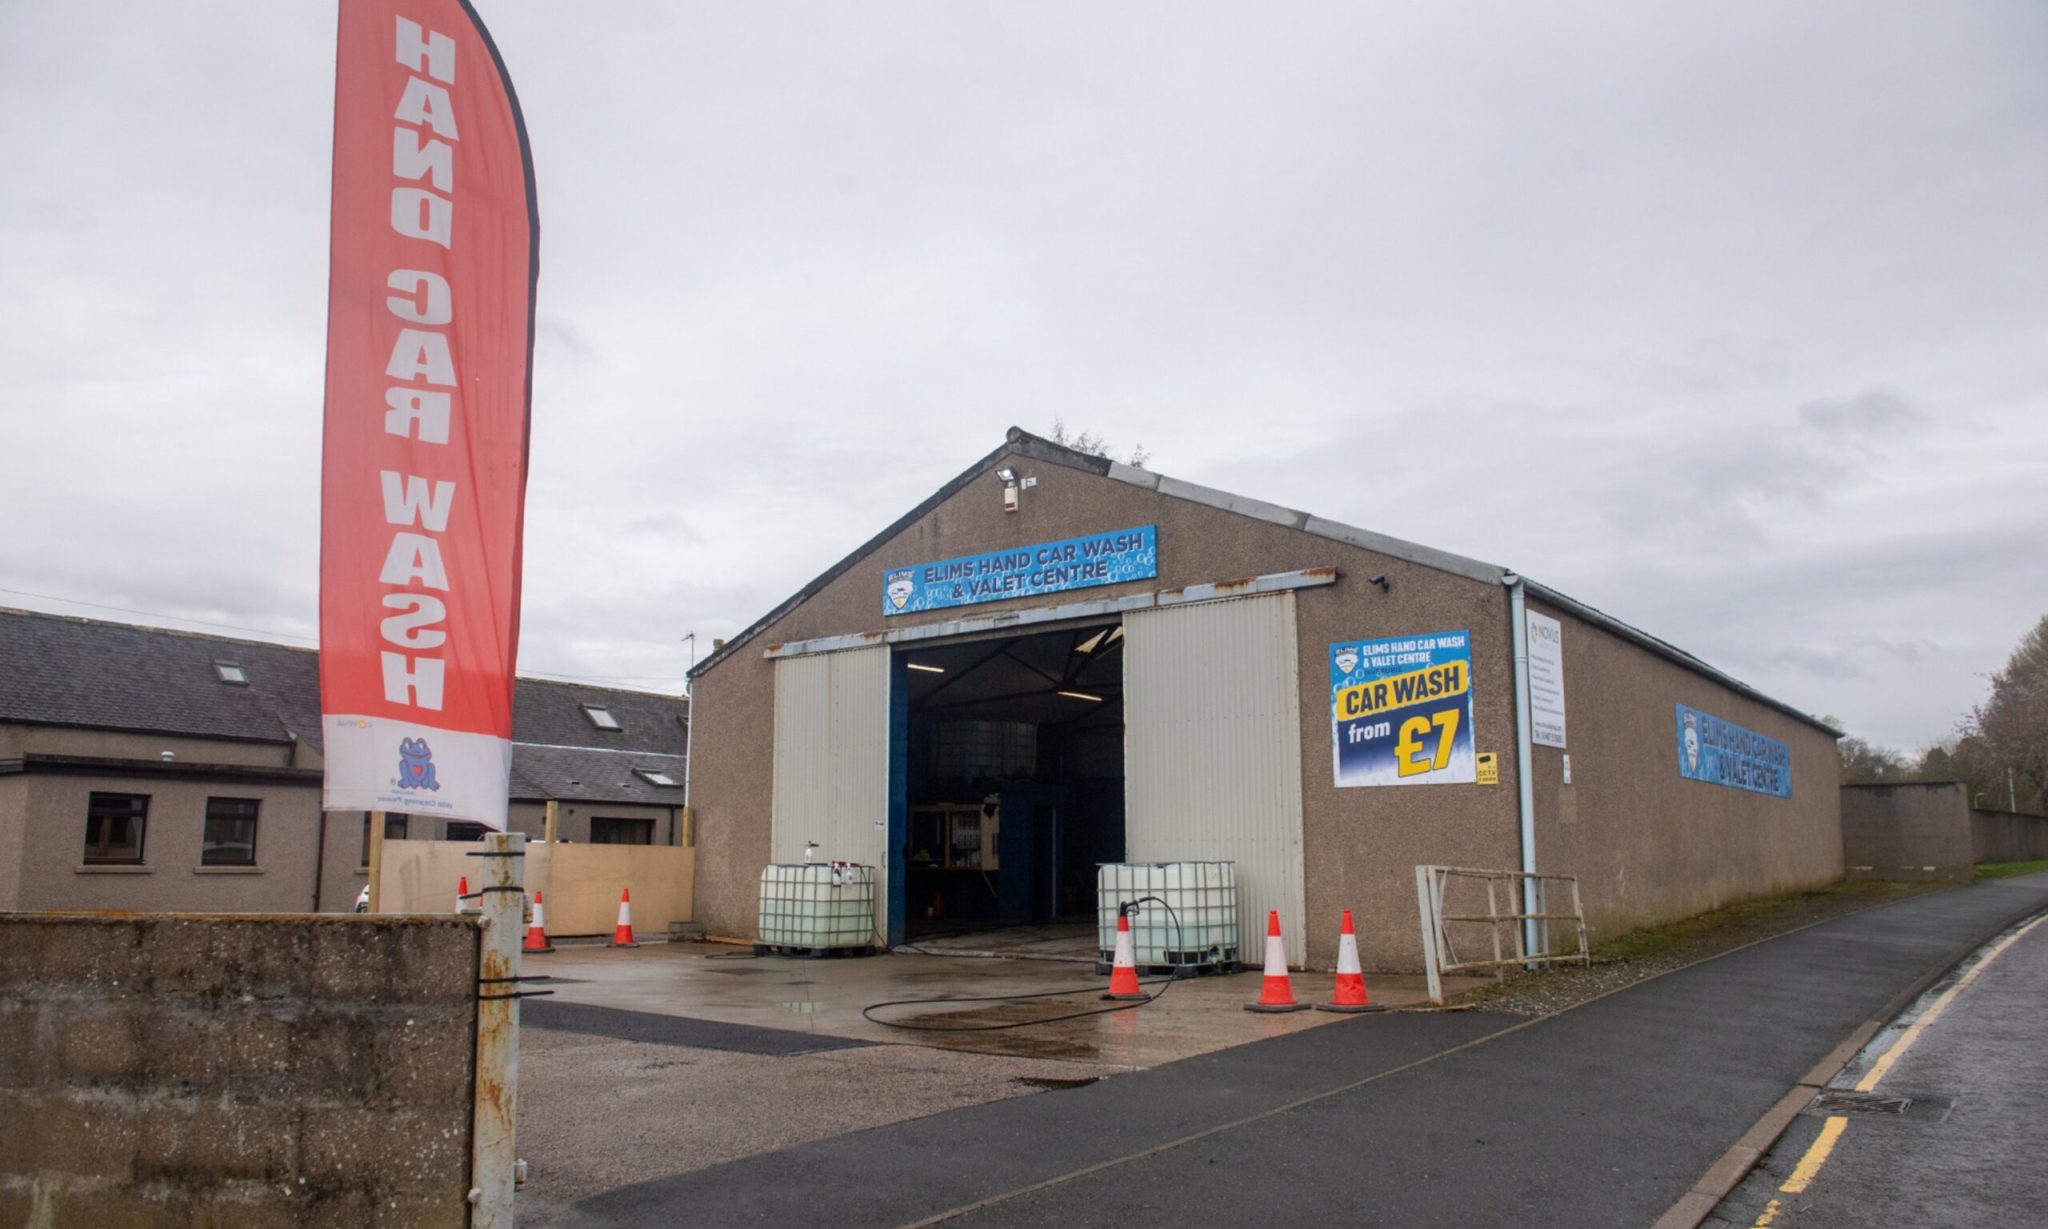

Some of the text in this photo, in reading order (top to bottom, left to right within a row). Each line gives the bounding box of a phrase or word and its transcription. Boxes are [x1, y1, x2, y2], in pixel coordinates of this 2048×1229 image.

[924, 532, 1144, 584] ELIMS HAND CAR WASH
[952, 560, 1109, 599] & VALET CENTRE
[1363, 636, 1465, 656] ELIMS HAND CAR WASH
[1363, 657, 1370, 668] &
[1371, 654, 1397, 668] VALET
[1397, 651, 1431, 665] CENTRE
[1346, 665, 1460, 715] CAR WASH
[1348, 708, 1460, 777] from £7
